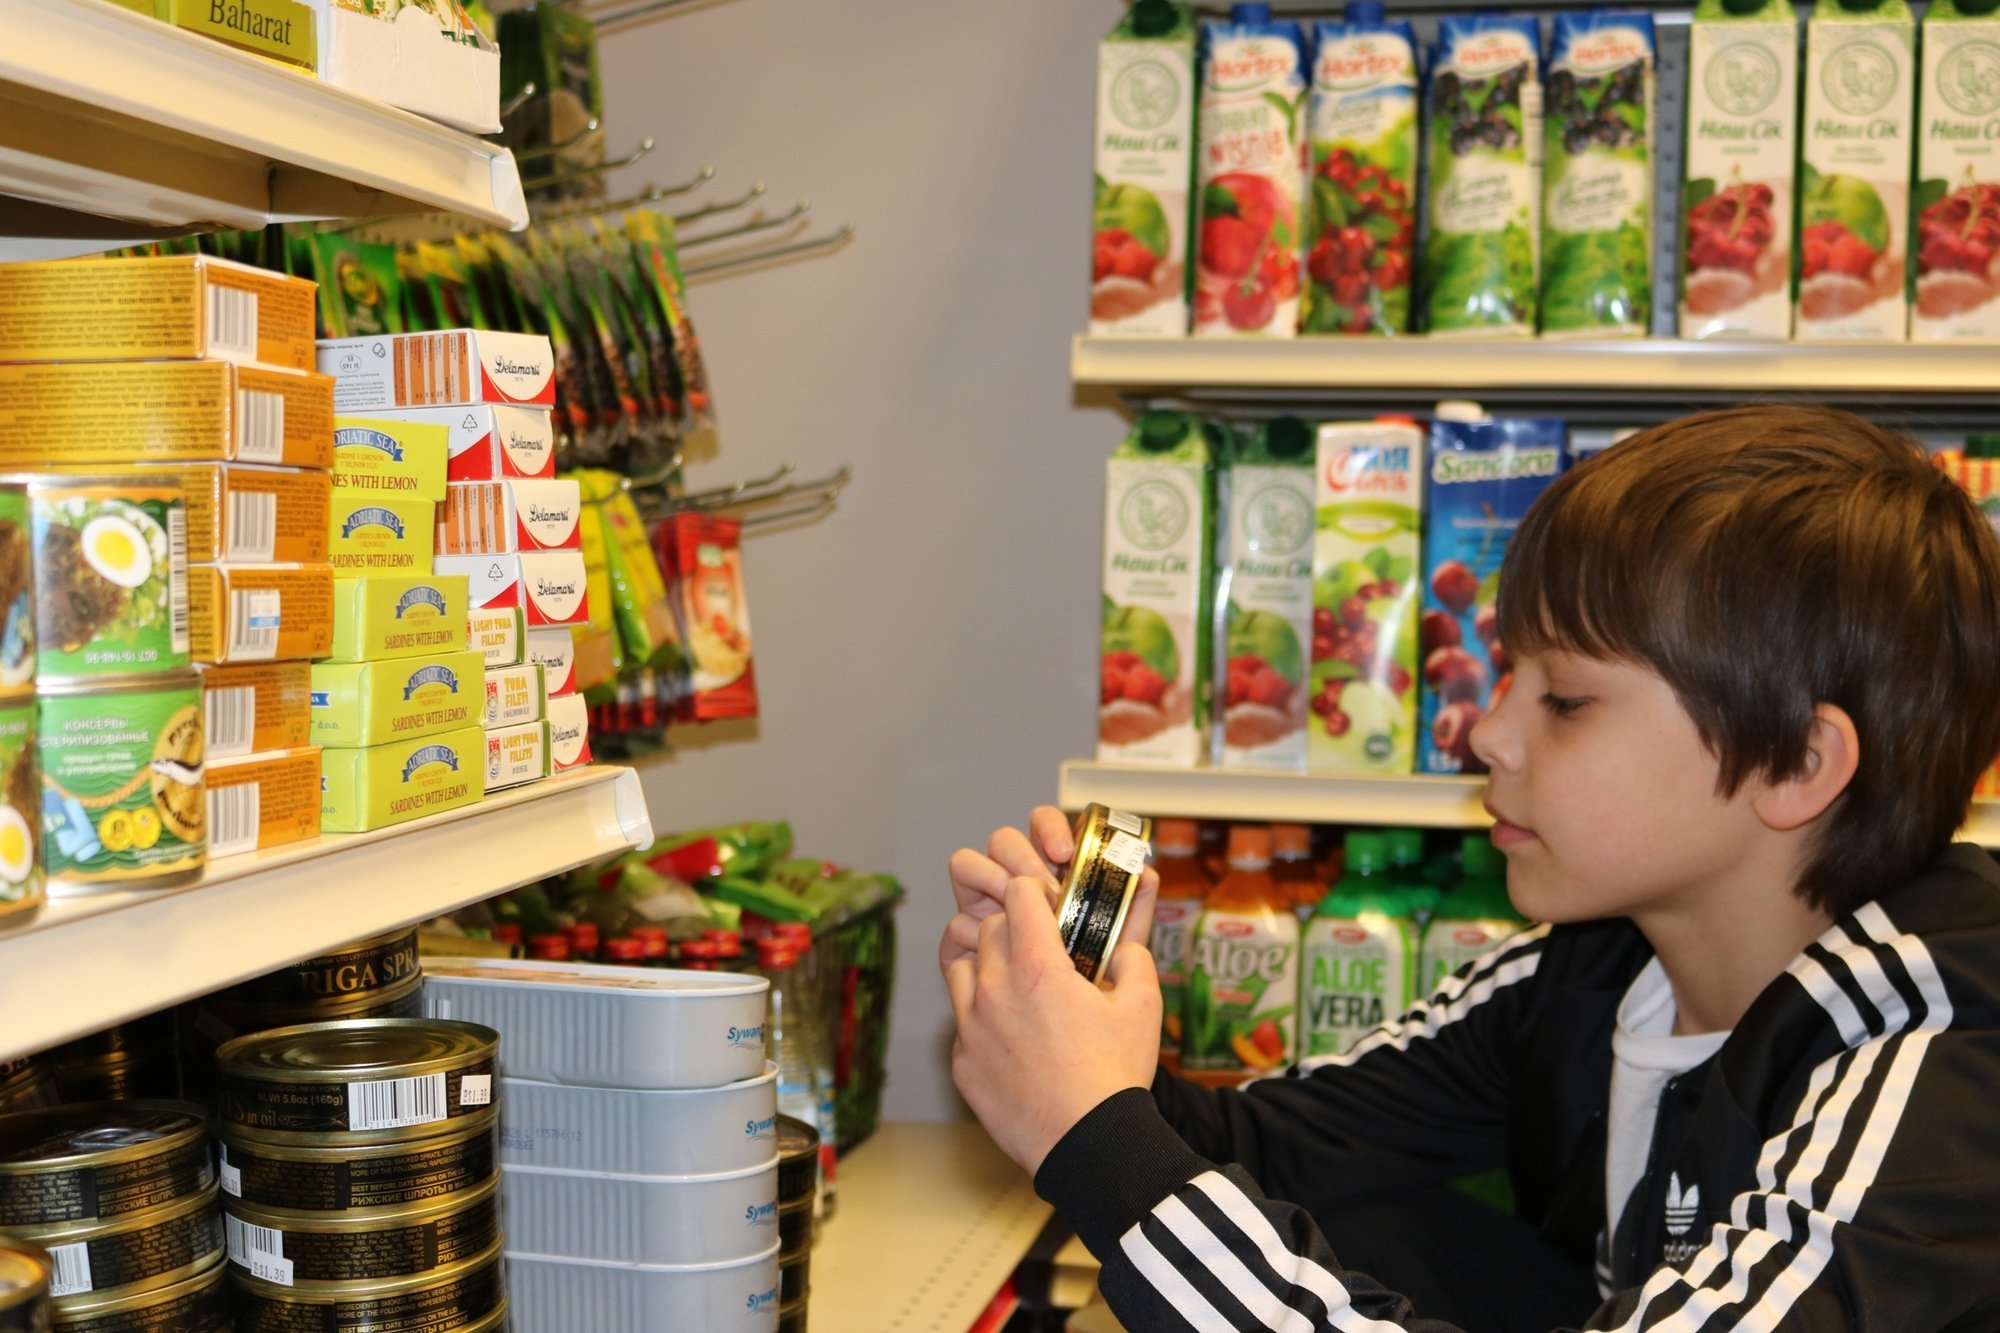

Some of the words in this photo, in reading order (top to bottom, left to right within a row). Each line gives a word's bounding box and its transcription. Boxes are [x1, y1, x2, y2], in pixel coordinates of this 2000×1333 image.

[208, 0, 291, 46] Baharat
[334, 430, 375, 446] DRIATIC
[376, 434, 395, 454] SEA
[351, 475, 379, 489] WITH
[381, 477, 418, 490] LEMON
[349, 508, 386, 527] ADRIATIC
[386, 512, 399, 530] SEA
[328, 554, 366, 568] SARDINES
[366, 554, 388, 568] WITH
[388, 554, 415, 568] LEMON
[474, 618, 494, 633] LIGHT
[494, 617, 512, 630] TUNA
[384, 633, 415, 649] SARDINES
[416, 631, 433, 646] WITH
[433, 629, 454, 645] LEMON
[481, 633, 506, 647] FILLETS
[504, 677, 528, 692] TUNA
[392, 713, 425, 732] SARDINES
[425, 710, 444, 726] WITH
[444, 706, 468, 723] LEMON
[489, 739, 500, 752] EVA
[502, 734, 522, 749] LIGHT
[521, 731, 539, 746] TUNA
[408, 746, 439, 770] ADRIATIC
[509, 748, 533, 763] FILLETS
[390, 793, 425, 815] SARDINES
[425, 788, 444, 804] WITH
[444, 783, 469, 801] LEMON
[1194, 937, 1287, 981] Aloe
[298, 961, 379, 995] RIGA
[1311, 956, 1388, 993] ALOE
[1307, 995, 1384, 1028] VERA
[282, 1095, 309, 1104] 5.6oz
[311, 1094, 344, 1108] (160g)
[261, 1110, 277, 1127] oil
[351, 1184, 369, 1193] BEST
[370, 1182, 397, 1191] BEFORE
[398, 1179, 415, 1189] DATE
[415, 1174, 438, 1185] SHOWN
[438, 1172, 447, 1181] ON
[99, 1196, 149, 1216] РИЖСКИЕ
[351, 1192, 402, 1206] РИЖСКИЕ
[404, 1185, 447, 1200] ШПРОТЫ
[259, 1262, 285, 1282] $1.39
[337, 1311, 356, 1319] MORE
[366, 1309, 379, 1317] THE
[357, 1323, 384, 1333] BEFORE
[385, 1321, 402, 1330] DATE
[403, 1315, 427, 1327] SHOWN
[428, 1313, 437, 1321] ON
[437, 1310, 448, 1319] THE
